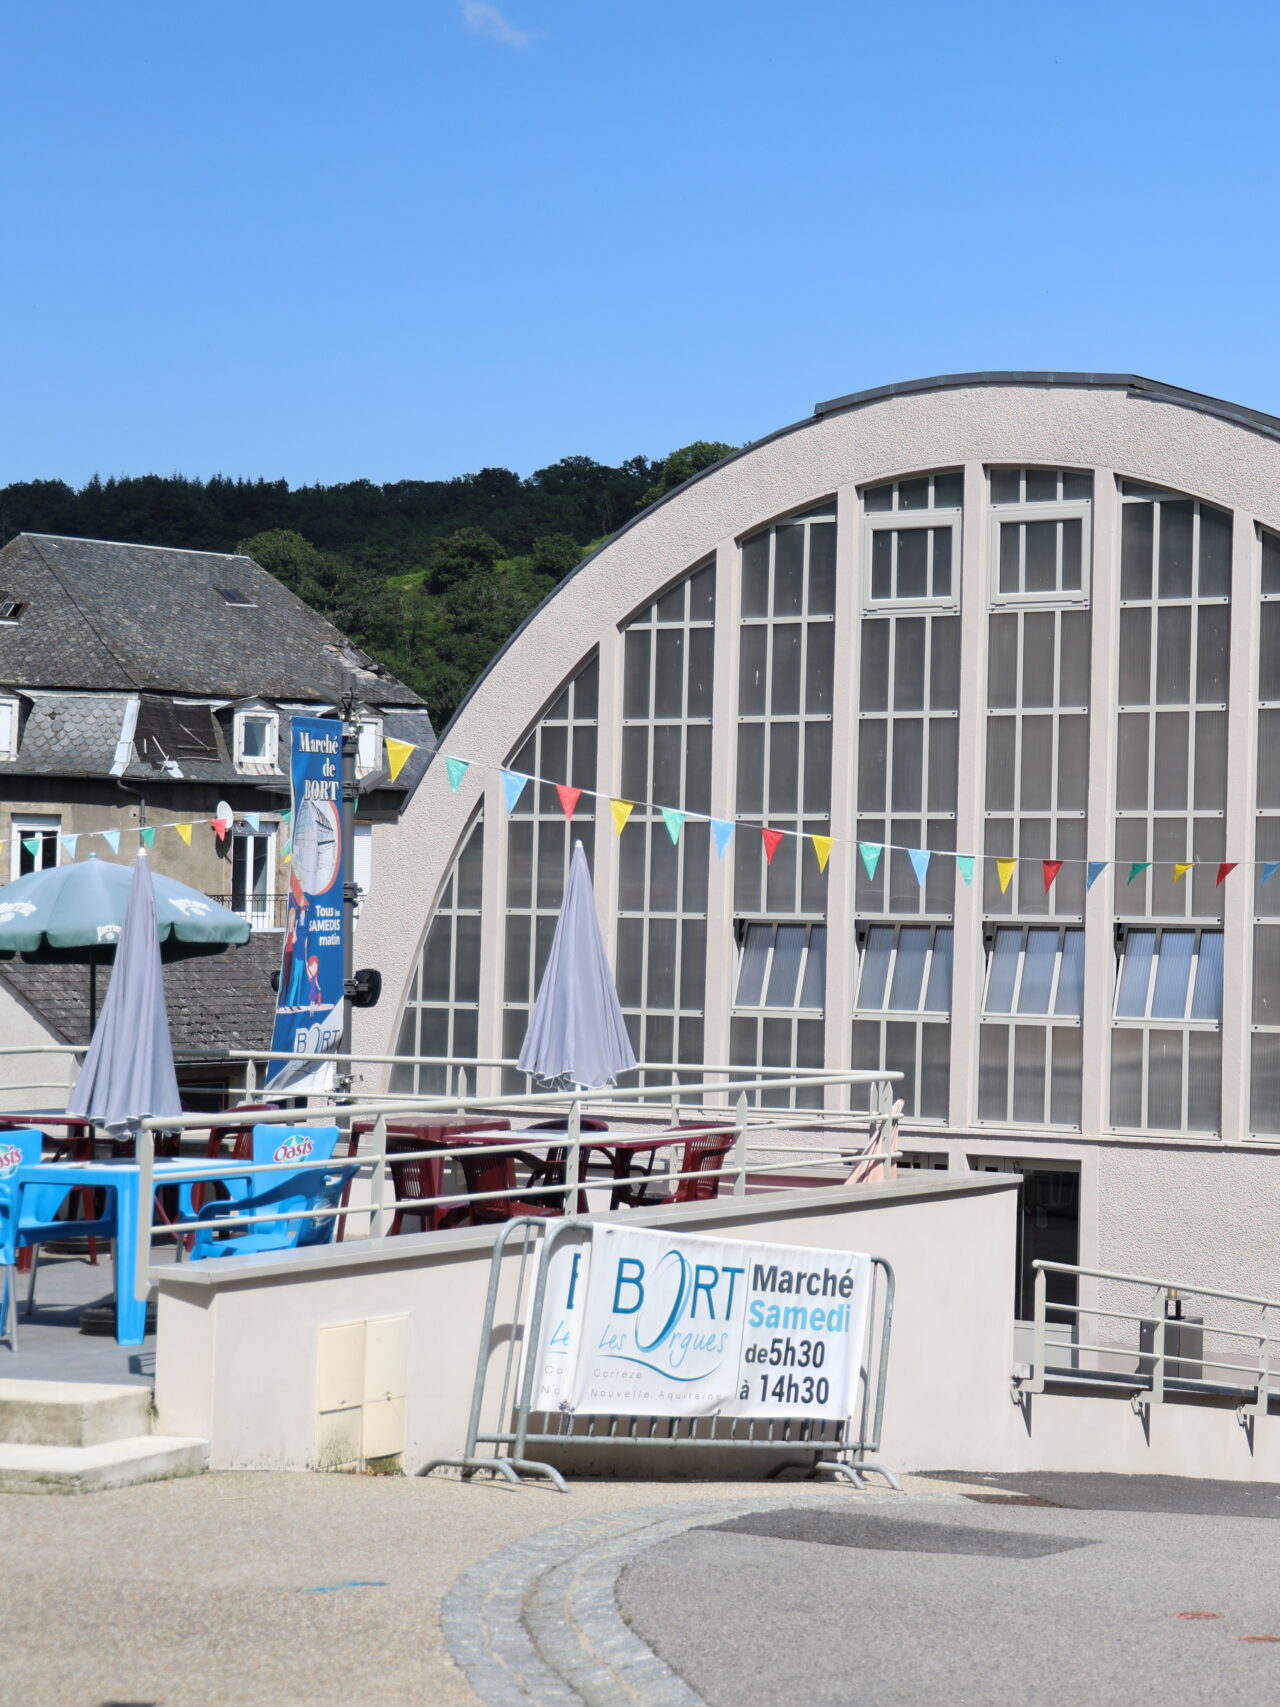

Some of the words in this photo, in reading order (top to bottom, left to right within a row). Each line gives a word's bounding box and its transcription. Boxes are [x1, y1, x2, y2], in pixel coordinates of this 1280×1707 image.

[299, 731, 339, 755] Marché
[322, 757, 336, 778] de
[304, 779, 339, 801] BORT
[315, 905, 334, 917] Tous
[309, 919, 341, 931] SAMEDIS
[319, 933, 341, 946] matin
[273, 1136, 315, 1162] Oasis
[752, 1264, 855, 1298] Marché
[612, 1250, 745, 1352] BORT
[749, 1299, 851, 1333] Samedi
[598, 1324, 627, 1350] Les
[590, 1388, 650, 1399] Nouvelle
[739, 1379, 750, 1400] à
[761, 1374, 829, 1404] 14h30
